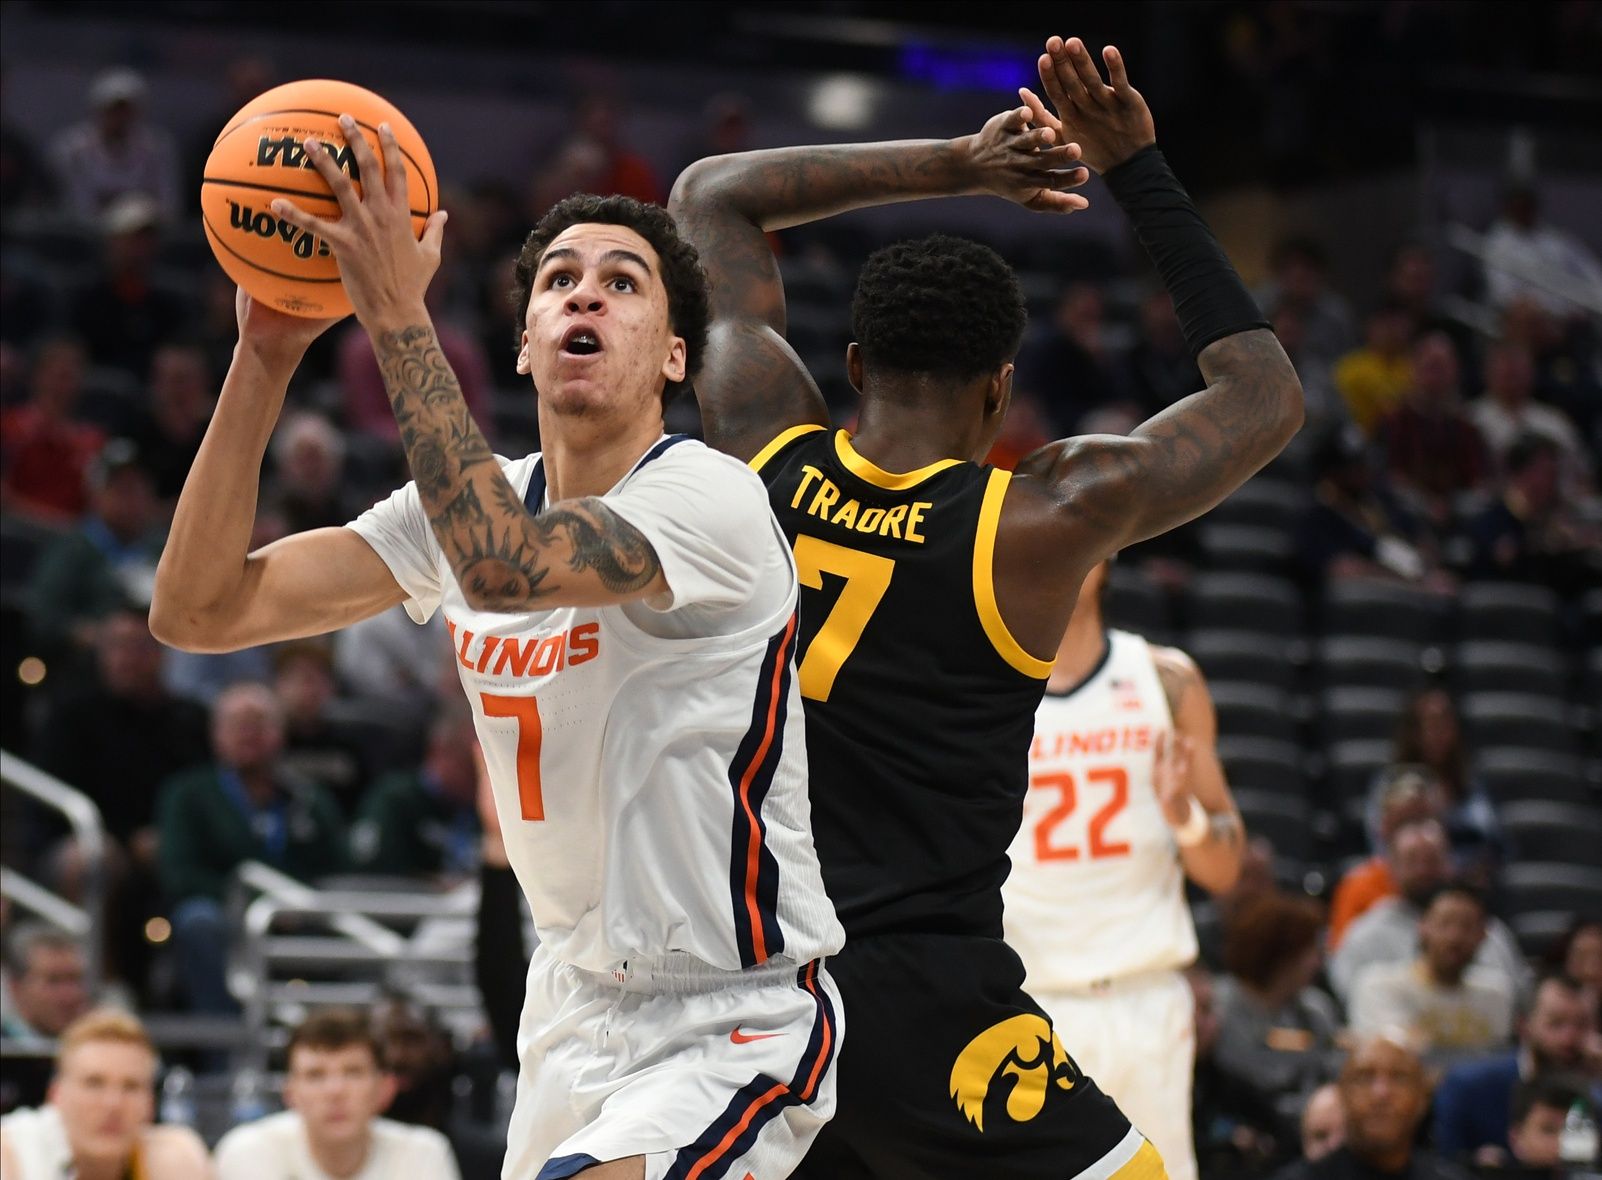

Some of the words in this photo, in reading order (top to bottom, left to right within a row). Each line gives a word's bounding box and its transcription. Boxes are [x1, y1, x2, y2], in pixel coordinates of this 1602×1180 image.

[230, 201, 331, 259] lson
[791, 464, 933, 544] TRAORE
[444, 616, 600, 677] LINOIS
[792, 533, 896, 703] 7
[479, 692, 545, 821] 7
[1030, 726, 1151, 760] LINOIS
[1031, 768, 1131, 863] 22
